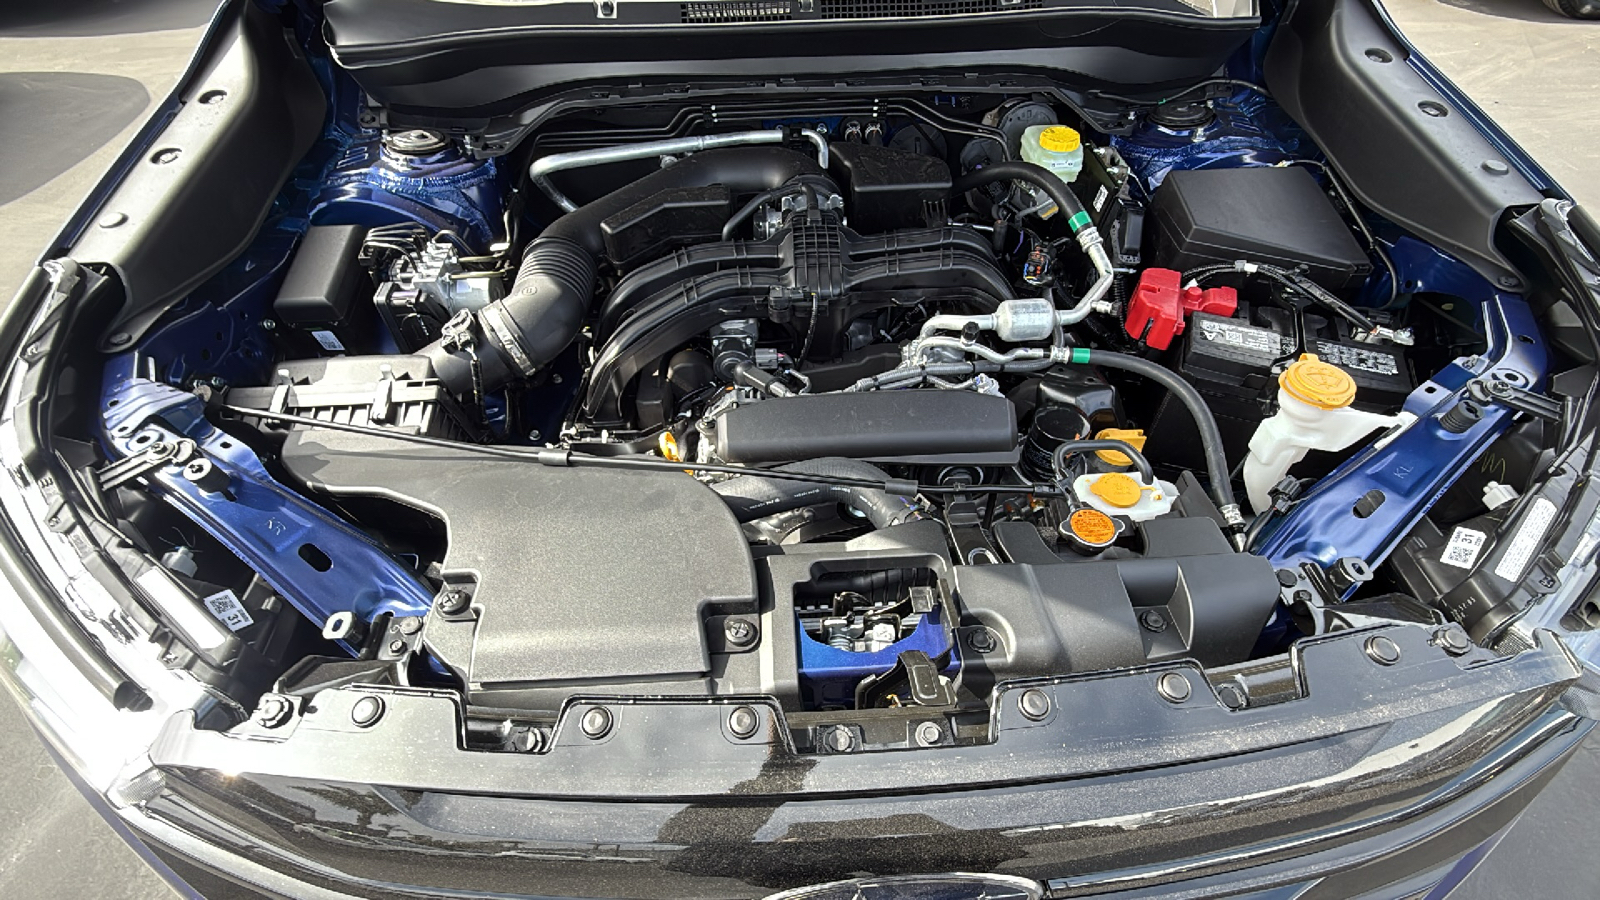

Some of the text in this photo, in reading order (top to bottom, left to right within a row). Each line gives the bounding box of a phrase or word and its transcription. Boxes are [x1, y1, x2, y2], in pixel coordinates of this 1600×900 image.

[1393, 465, 1414, 479] KL
[1461, 533, 1475, 544] 31
[227, 613, 242, 626] 31
